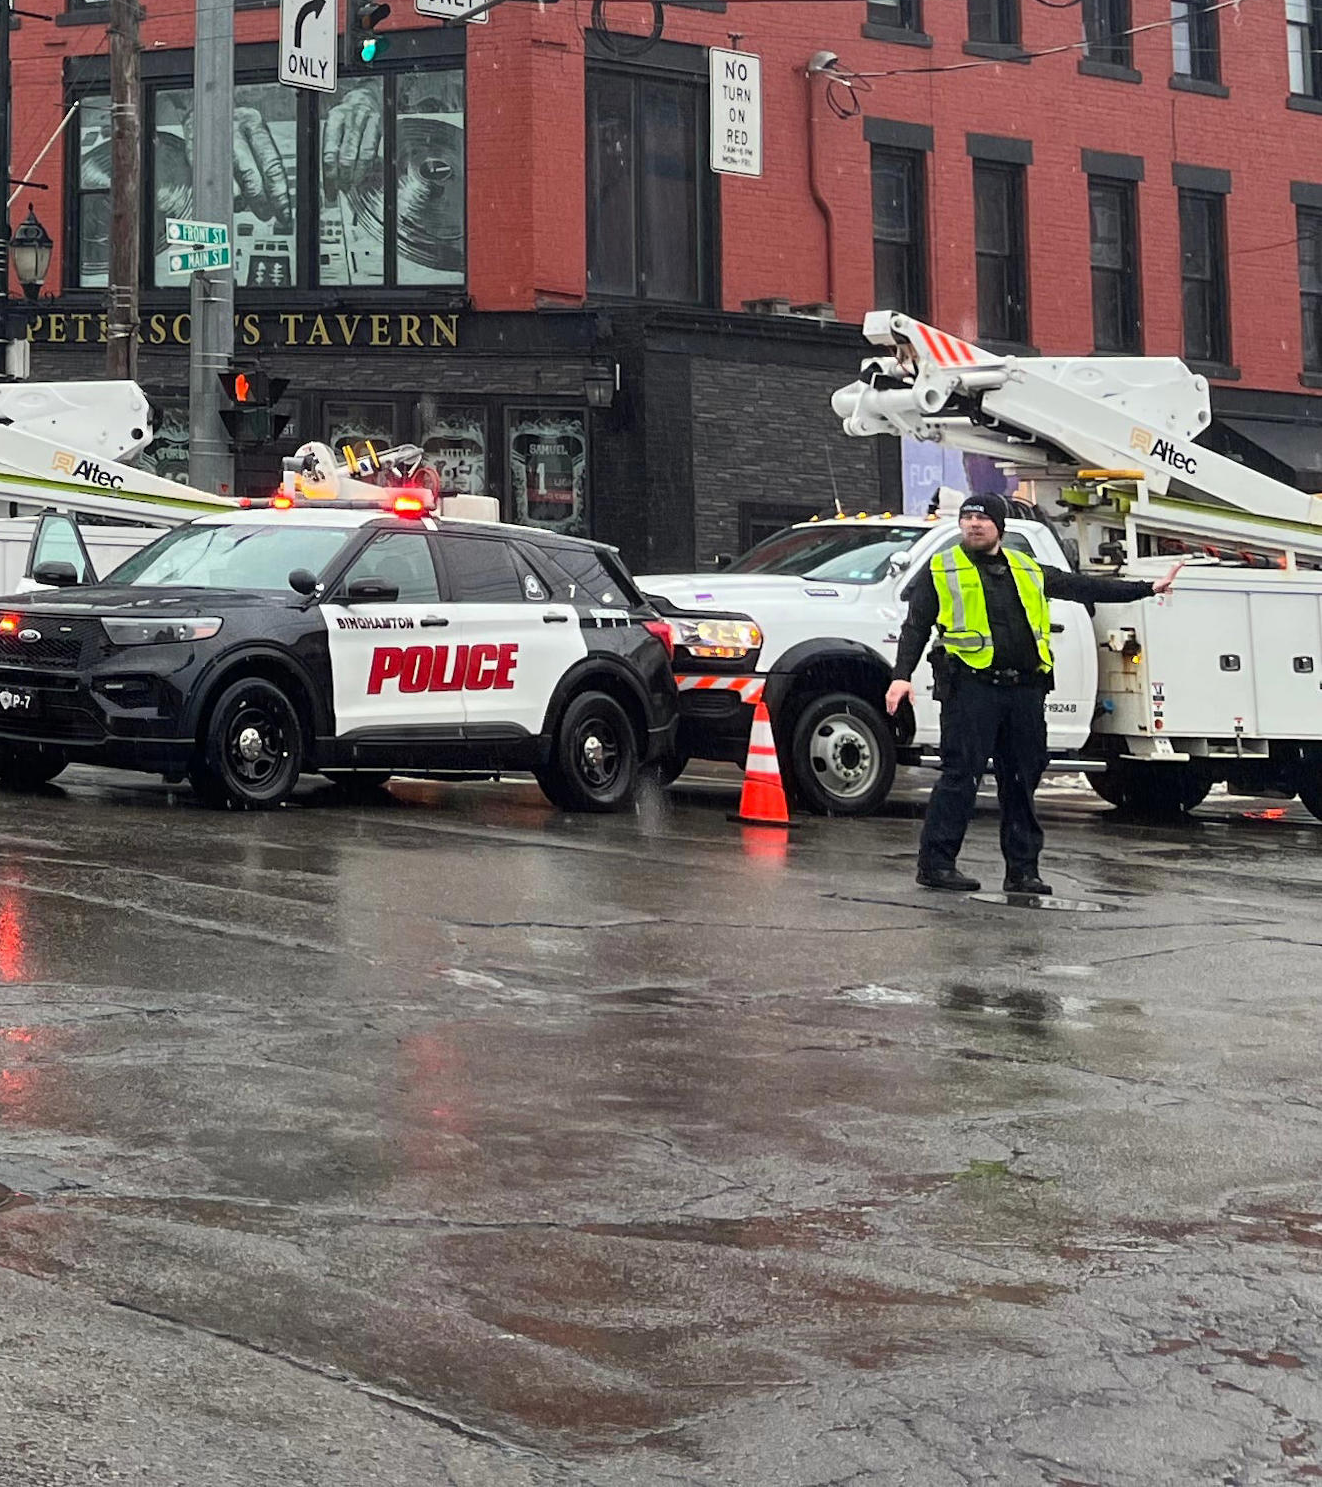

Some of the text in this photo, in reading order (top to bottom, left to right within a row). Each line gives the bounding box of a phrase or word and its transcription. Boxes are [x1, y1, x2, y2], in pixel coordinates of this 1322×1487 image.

[288, 54, 329, 79] ONLY
[725, 60, 748, 81] NO
[722, 84, 751, 104] TURN
[729, 107, 745, 123] ON
[726, 128, 748, 146] RED
[182, 224, 223, 244] FRONT ST
[187, 249, 223, 269] MAIN ST
[26, 313, 460, 347] PETESO'S TAVERN
[529, 443, 570, 456] SAMUEL
[1150, 439, 1197, 475] Altec
[71, 459, 124, 490] Altec
[536, 462, 548, 495] 1
[336, 617, 415, 630] BINGHAMTON
[366, 643, 520, 695] POLICE
[12, 694, 31, 709] P-7
